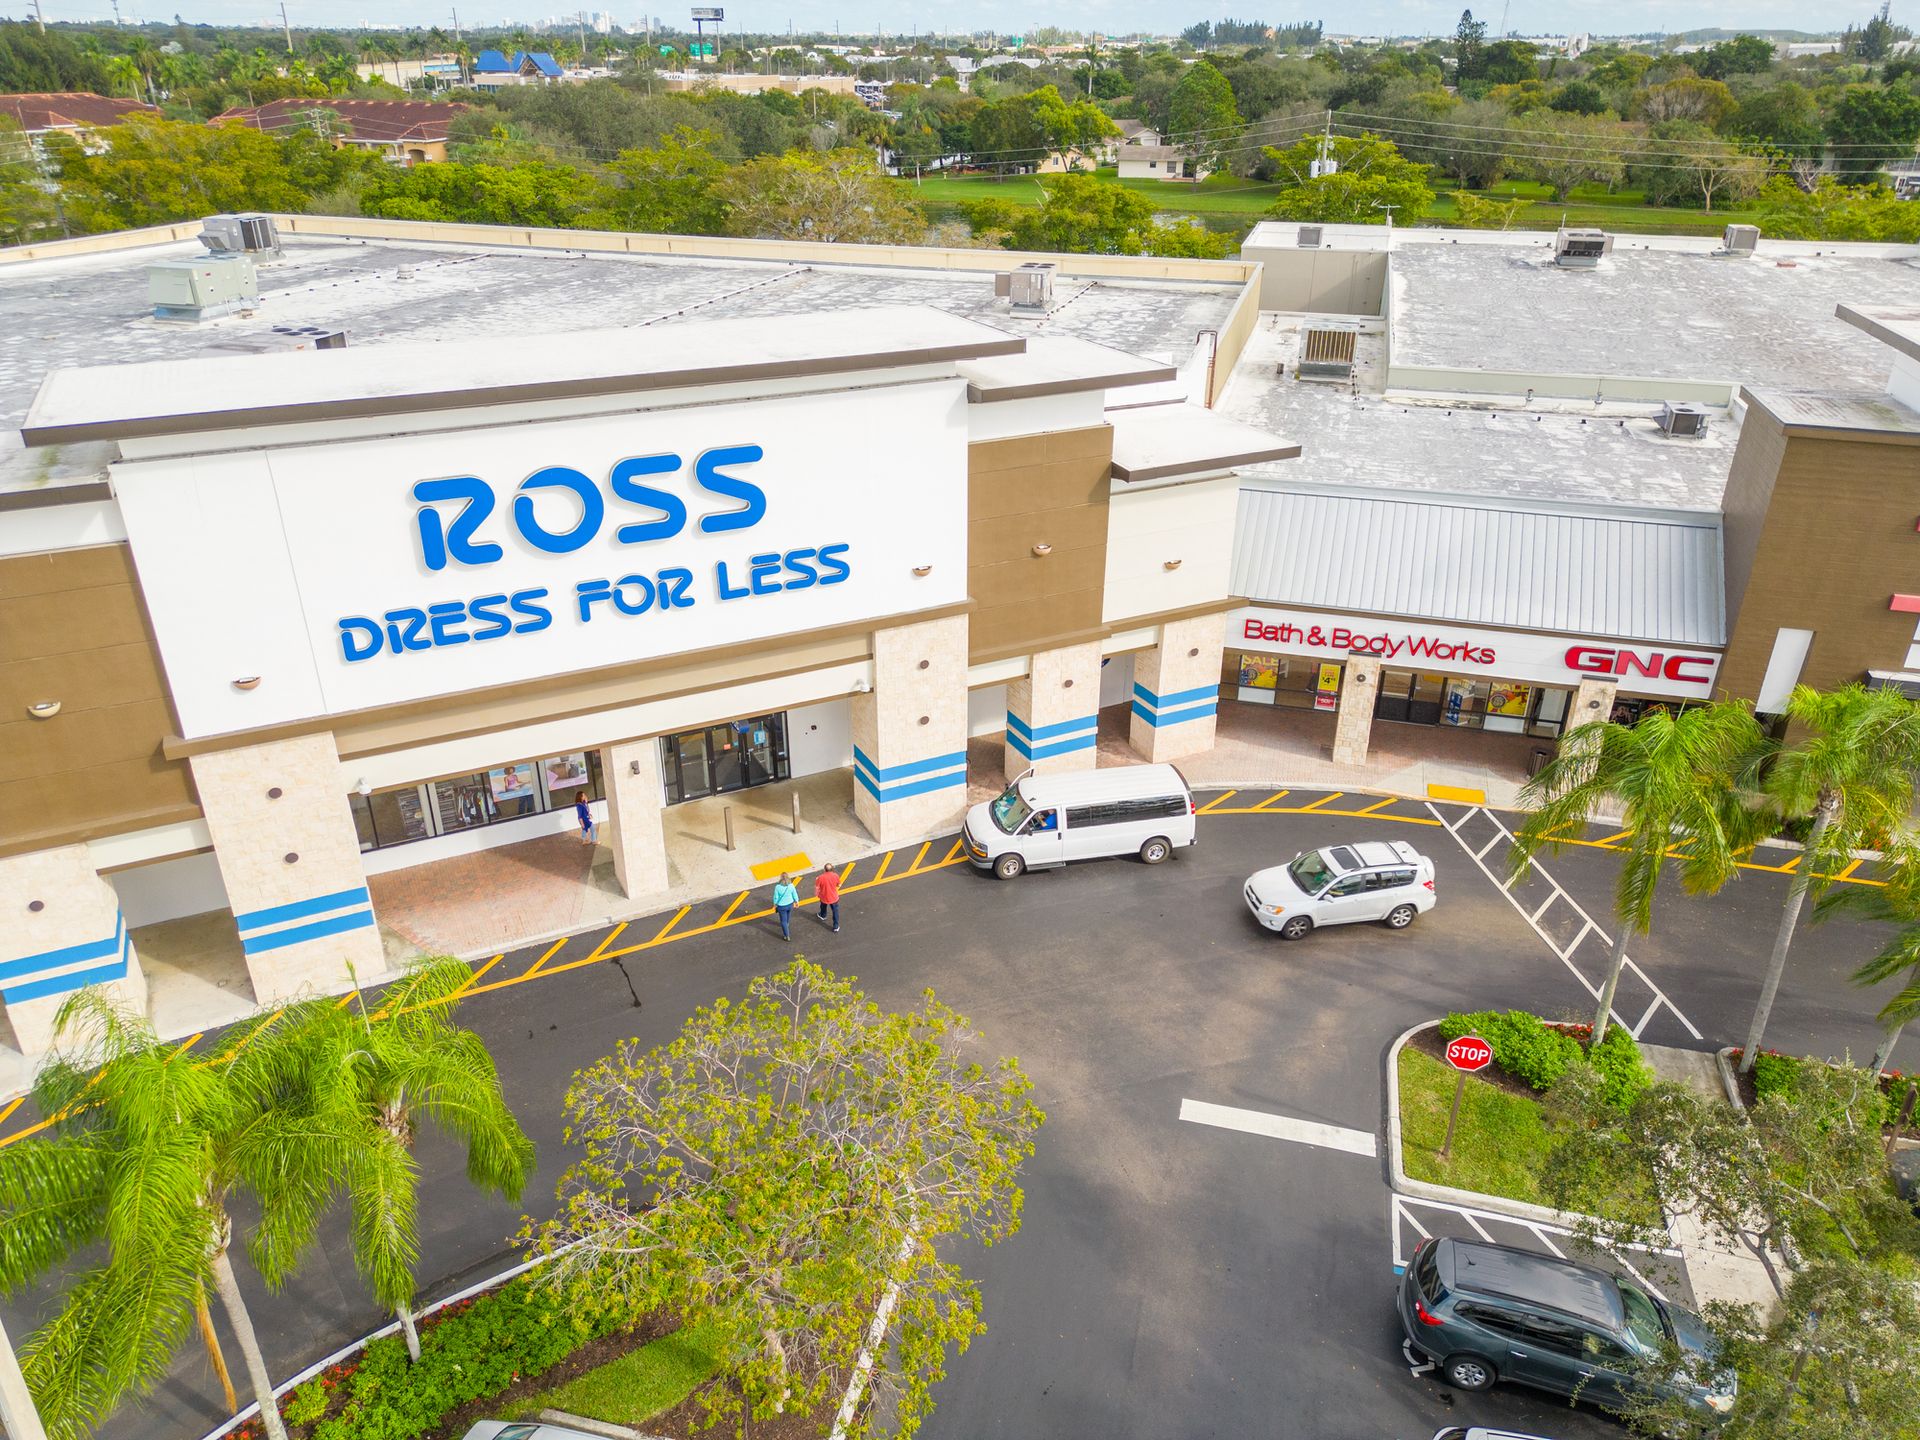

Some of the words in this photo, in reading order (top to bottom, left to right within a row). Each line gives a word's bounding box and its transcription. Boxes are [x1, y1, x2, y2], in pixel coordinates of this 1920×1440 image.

[413, 445, 768, 571] ROSS
[338, 588, 553, 662] DRESS
[575, 567, 696, 623] FOR
[716, 543, 851, 601] LESS
[1242, 655, 1279, 666] SALE
[1243, 618, 1304, 645] Bath
[1306, 625, 1328, 647] &
[1331, 627, 1405, 659] Body
[1407, 635, 1497, 665] Works
[1564, 646, 1715, 684] GNC
[1492, 682, 1530, 692] SALE
[1449, 1045, 1489, 1062] STOP
